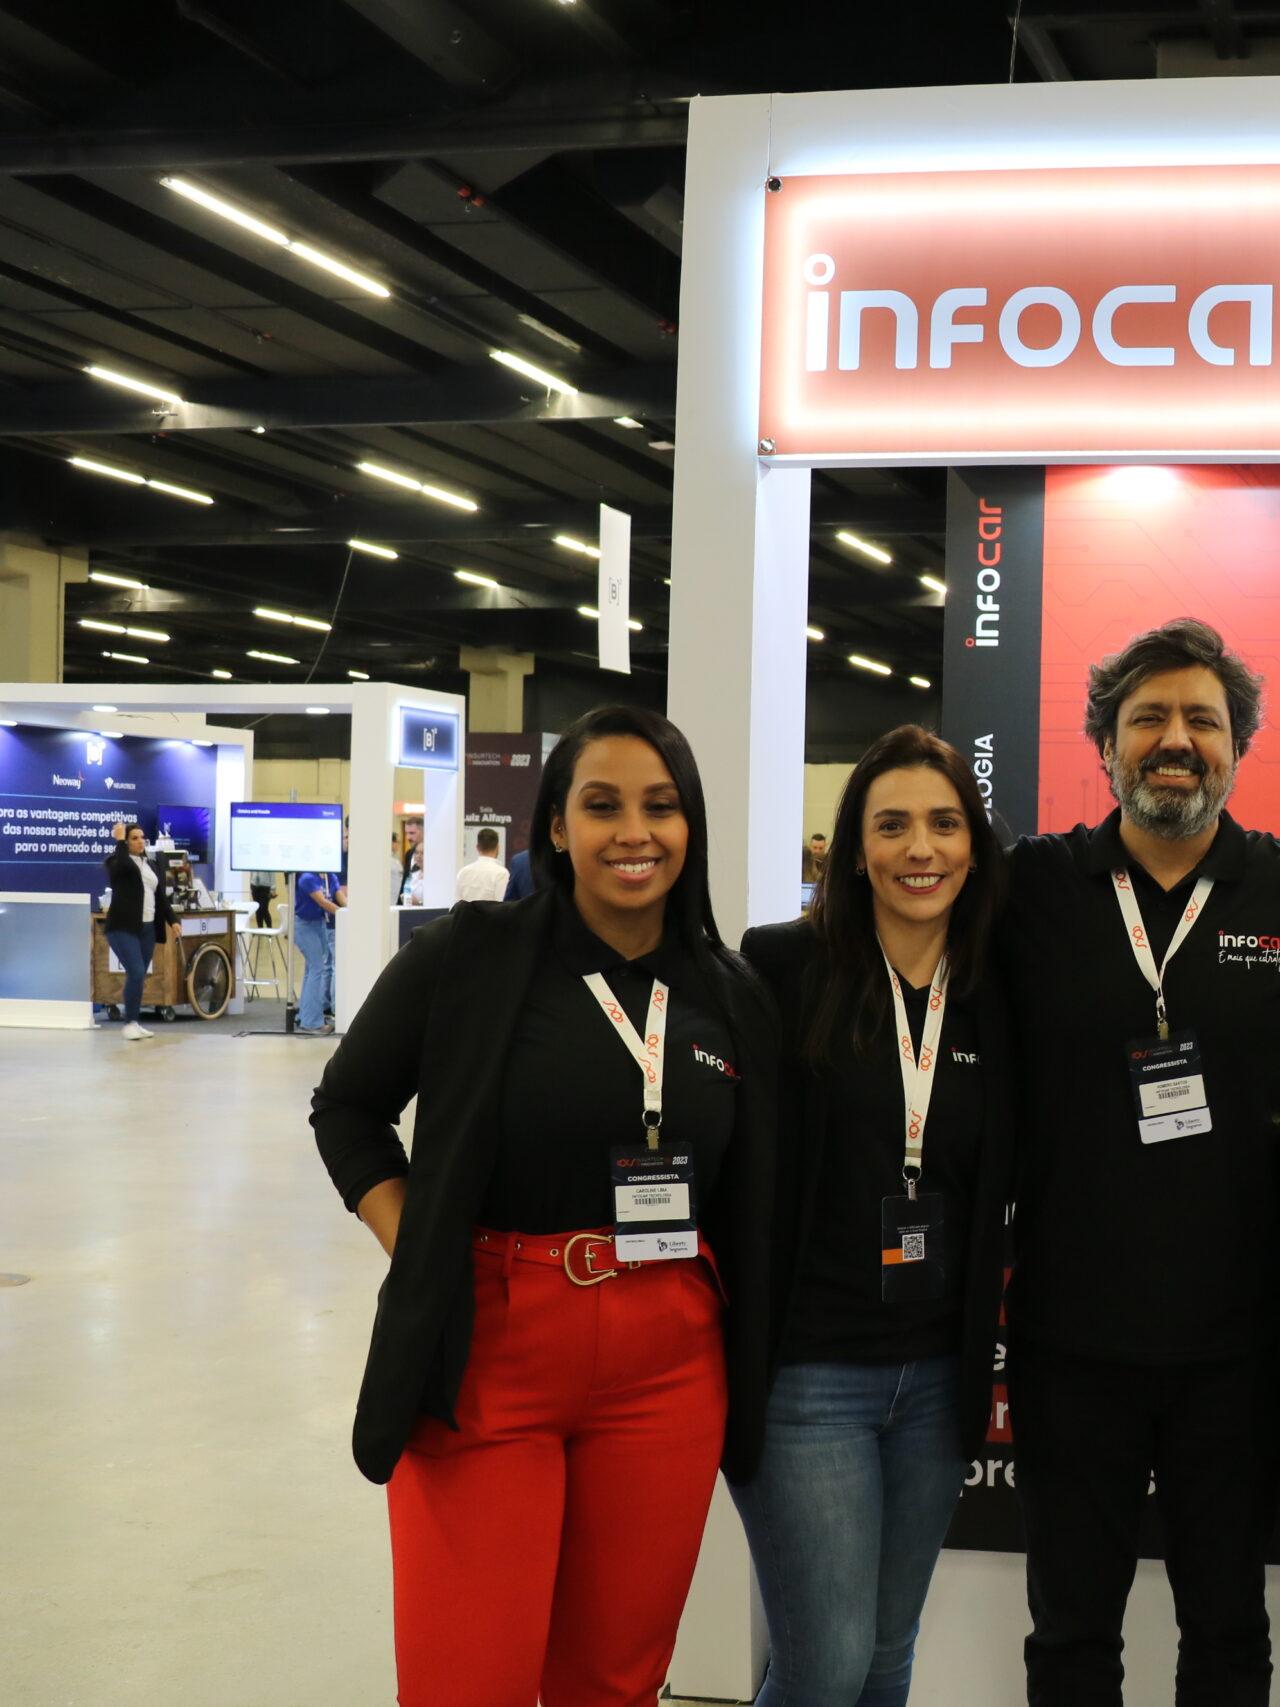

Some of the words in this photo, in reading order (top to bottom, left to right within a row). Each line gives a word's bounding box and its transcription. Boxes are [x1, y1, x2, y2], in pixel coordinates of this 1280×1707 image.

[53, 774, 81, 790] Neoway
[17, 809, 28, 819] as
[30, 808, 79, 822] vantagens
[81, 810, 138, 825] competitivas
[3, 823, 21, 835] das
[23, 826, 56, 836] nossas
[58, 825, 97, 839] soluções
[98, 826, 110, 837] de
[15, 841, 39, 854] para
[40, 843, 46, 852] o
[48, 841, 89, 854] mercado
[91, 842, 102, 854] de
[1142, 1059, 1187, 1071] CONGRESSISTA
[627, 1174, 679, 1182] CONGRESSISTA
